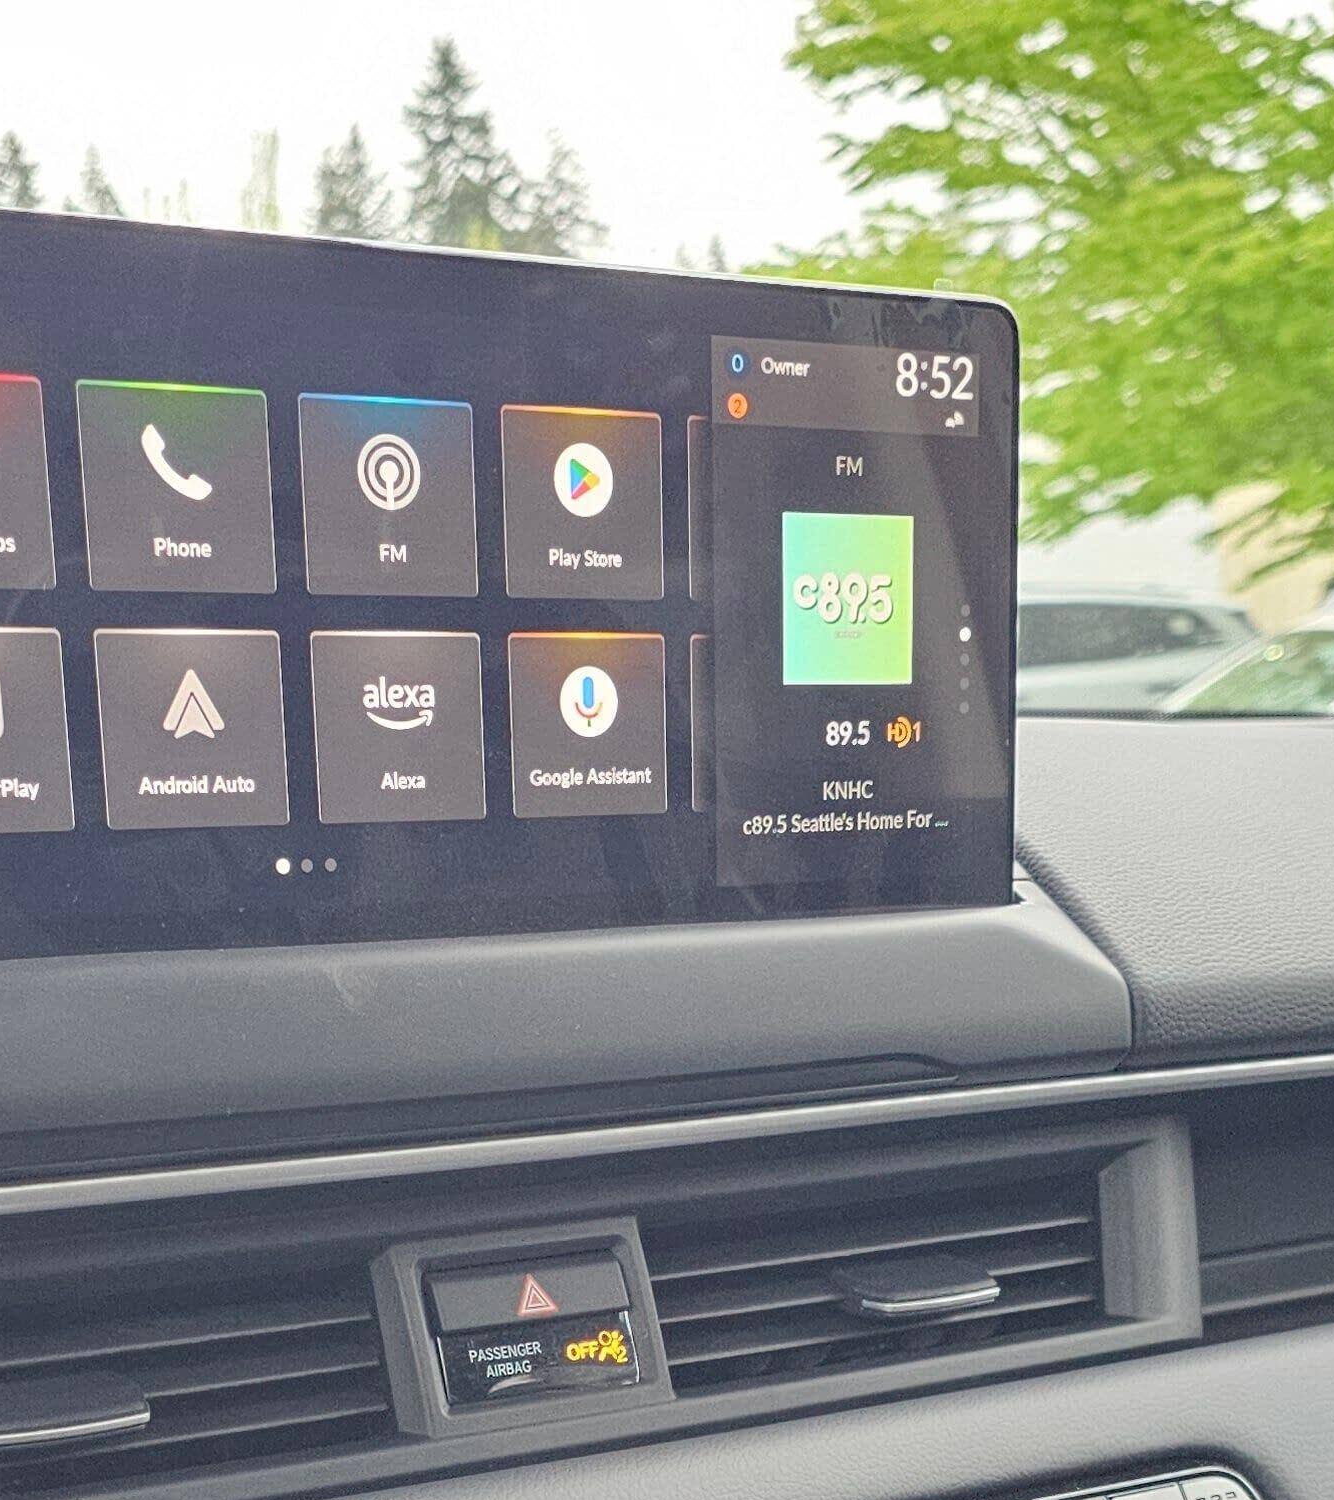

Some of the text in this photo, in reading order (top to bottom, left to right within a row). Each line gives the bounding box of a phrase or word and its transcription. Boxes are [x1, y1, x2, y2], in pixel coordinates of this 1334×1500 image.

[760, 356, 811, 378] Owner
[895, 351, 974, 401] 8:52
[835, 455, 864, 477] FM
[153, 537, 213, 559] Phone
[378, 544, 408, 564] FM
[548, 548, 623, 570] Play Store
[362, 676, 435, 709] alexa
[825, 720, 871, 746] 89.5
[138, 775, 256, 796] Android Auto
[380, 772, 427, 791] Alexa
[529, 767, 653, 789] Google Assistant
[822, 780, 874, 801] KNHC
[742, 814, 788, 836] c89.5
[791, 812, 854, 834] Seattle's
[857, 811, 904, 831] Home
[467, 1340, 542, 1364] PASSENGER
[566, 1340, 599, 1362] OFF
[485, 1360, 533, 1379] AIRBAG
